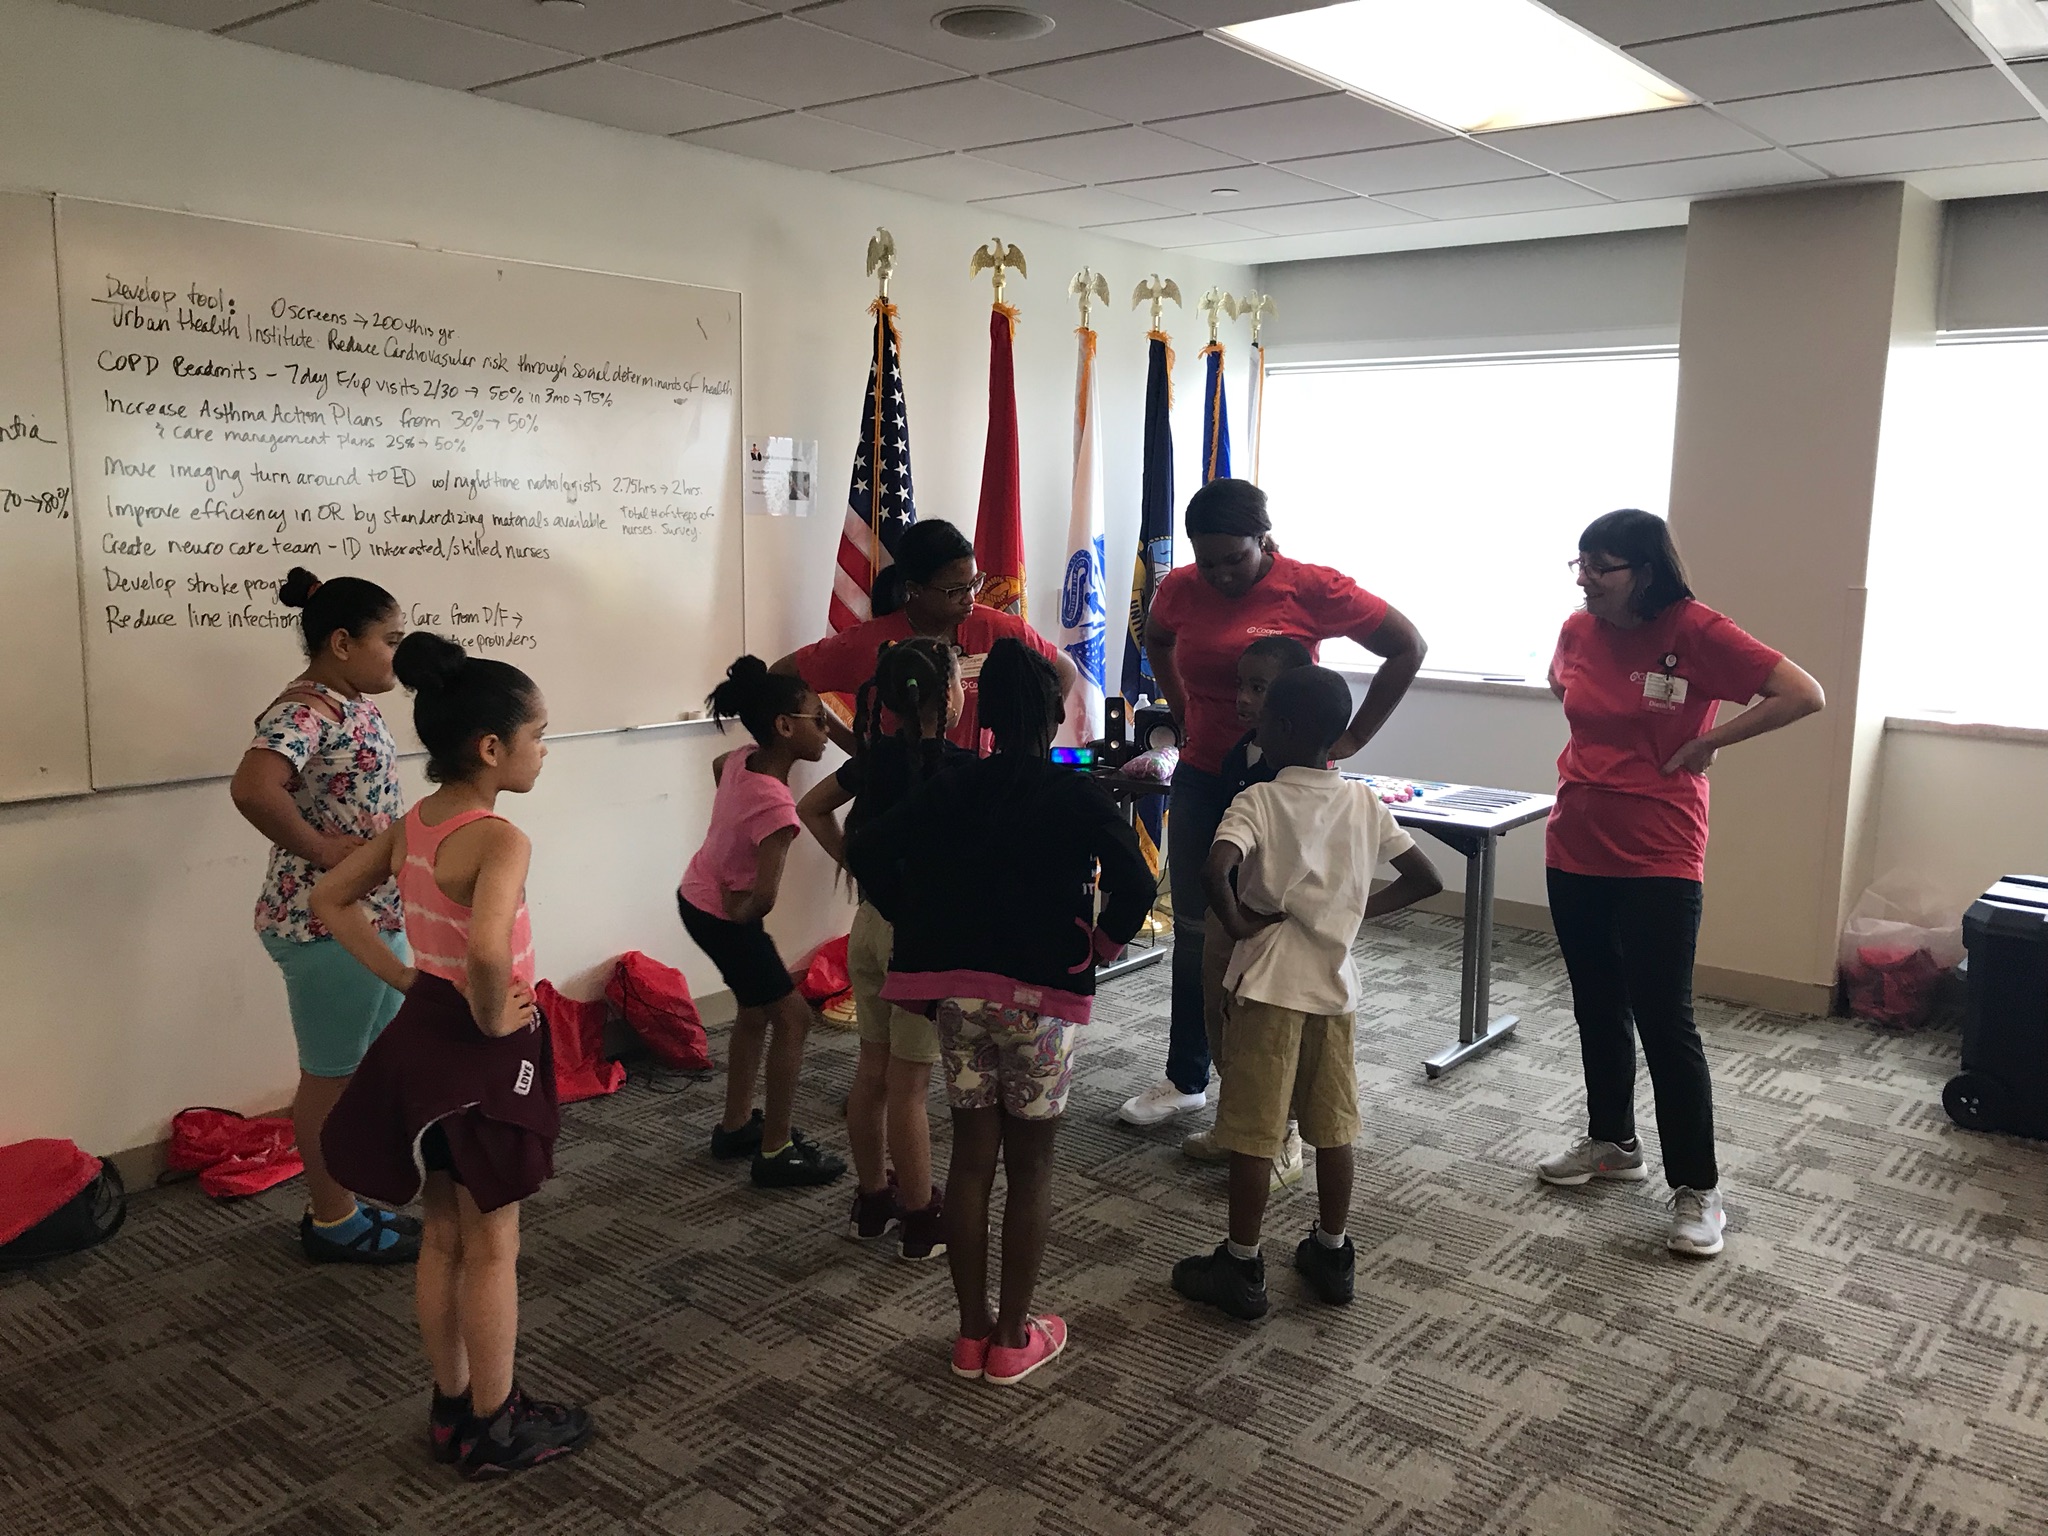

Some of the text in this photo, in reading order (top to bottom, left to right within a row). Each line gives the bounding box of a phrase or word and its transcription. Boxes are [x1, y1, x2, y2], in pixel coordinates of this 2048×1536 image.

[106, 273, 176, 311] Develop
[373, 312, 403, 331] 200
[112, 305, 170, 332] Urban
[176, 307, 240, 340] Health
[247, 314, 316, 350] Institute
[327, 329, 380, 357] Reduce
[482, 351, 509, 372] risk
[517, 353, 567, 381] through
[702, 376, 733, 396] health
[97, 349, 159, 376] COPD
[376, 376, 420, 397] visits
[423, 380, 460, 400] 2/30
[489, 386, 525, 404] 50%
[529, 389, 541, 404] in
[583, 389, 614, 408] 75%
[104, 389, 540, 434] Increase Asthma Action Plans from 30% 50%
[224, 431, 331, 453] management
[337, 433, 376, 449] plans
[386, 433, 416, 450] 25%
[434, 434, 467, 453] 50%
[104, 455, 158, 479] Move
[170, 462, 246, 499] imaging
[251, 462, 291, 485] turn
[296, 466, 361, 487] around
[368, 466, 387, 482] to
[391, 465, 417, 488] ED
[41, 486, 70, 520] 80%
[107, 494, 609, 539] Improve efficiency in OR by standardizing materials available
[102, 532, 157, 556] Create
[168, 541, 224, 556] neuro
[229, 541, 269, 556] care
[271, 538, 322, 556] team
[505, 544, 551, 561] nurses
[102, 566, 289, 606] Develop stroke progr
[105, 604, 177, 634] Reduce
[188, 602, 223, 629] line
[412, 602, 442, 627] Care
[451, 602, 480, 626] from
[476, 632, 538, 654] providers
[518, 1064, 533, 1091] LOVE
